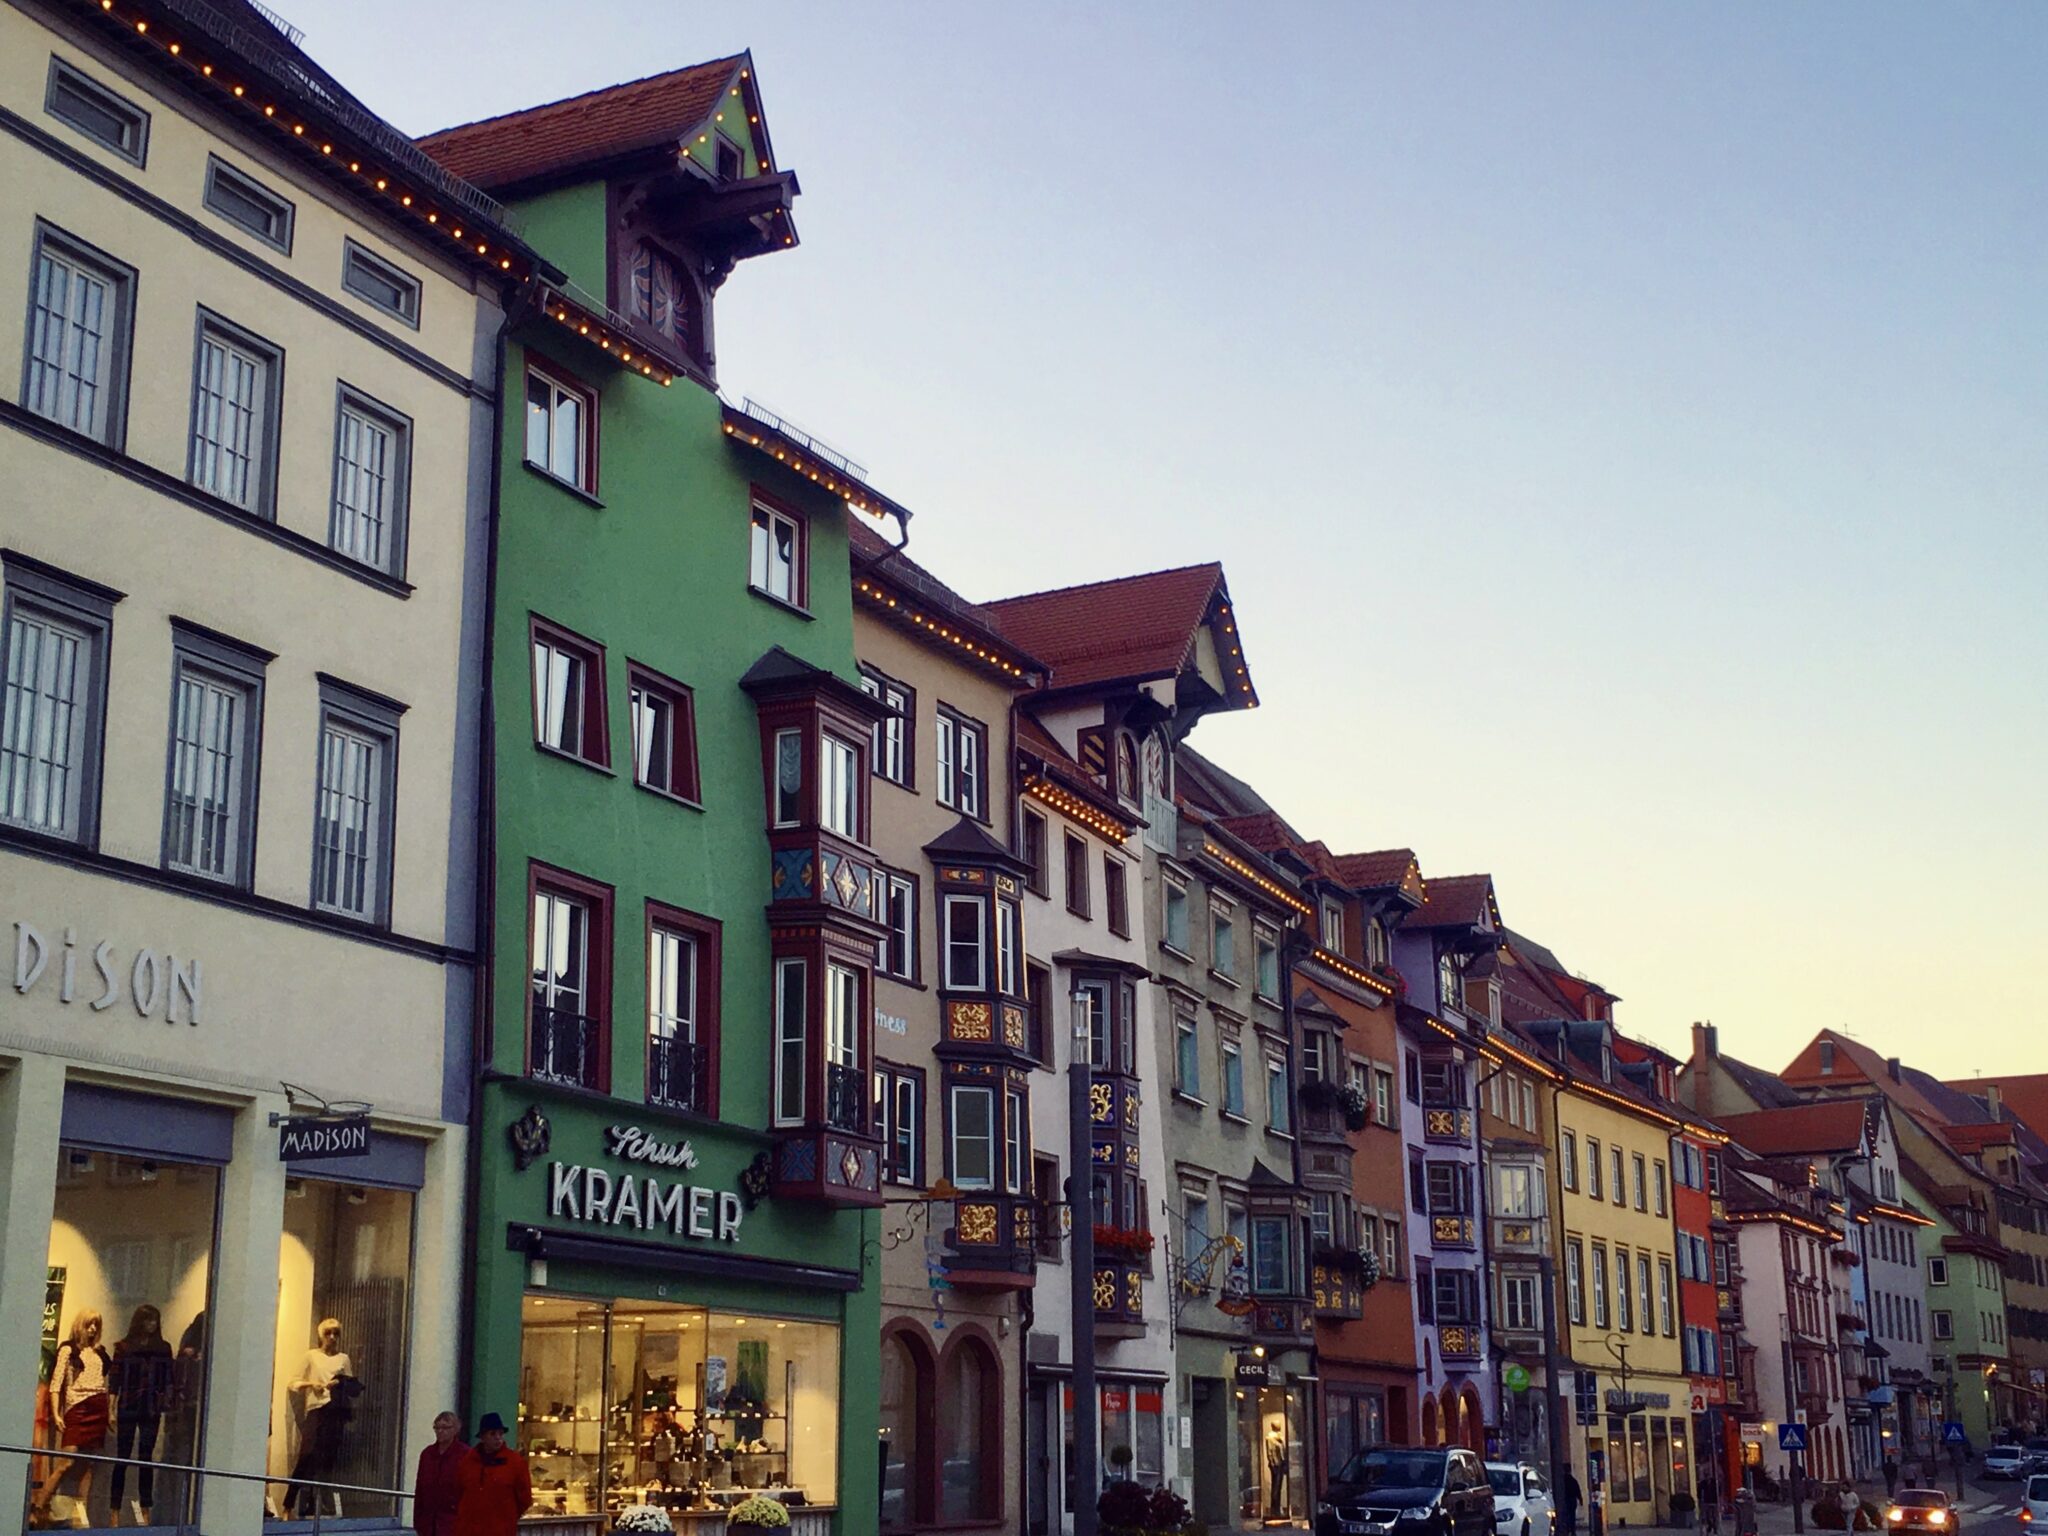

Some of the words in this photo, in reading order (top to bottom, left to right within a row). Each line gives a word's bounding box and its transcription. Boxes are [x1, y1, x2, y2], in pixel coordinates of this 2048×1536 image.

[609, 1125, 700, 1170] Schuh
[550, 1161, 744, 1242] KRAMER
[1239, 1365, 1265, 1375] CECIL
